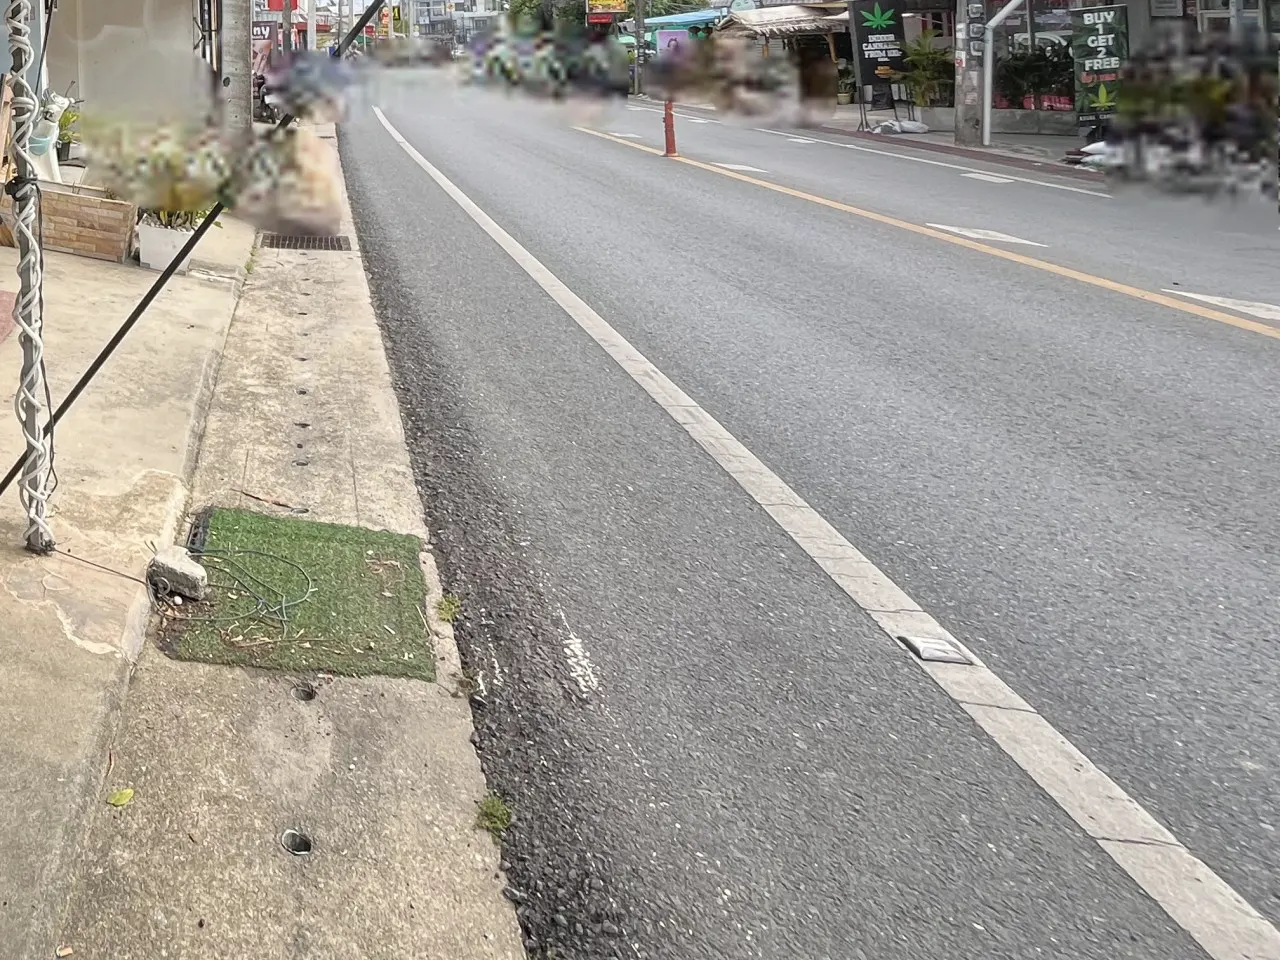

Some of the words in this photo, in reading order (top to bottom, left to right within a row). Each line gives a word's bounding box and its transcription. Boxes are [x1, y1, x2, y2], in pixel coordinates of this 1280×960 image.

[1083, 11, 1115, 25] BUY
[253, 26, 270, 39] ny
[1095, 24, 1104, 34] 1
[1087, 34, 1115, 47] GET
[1096, 47, 1107, 58] 2
[1084, 57, 1120, 71] FREE
